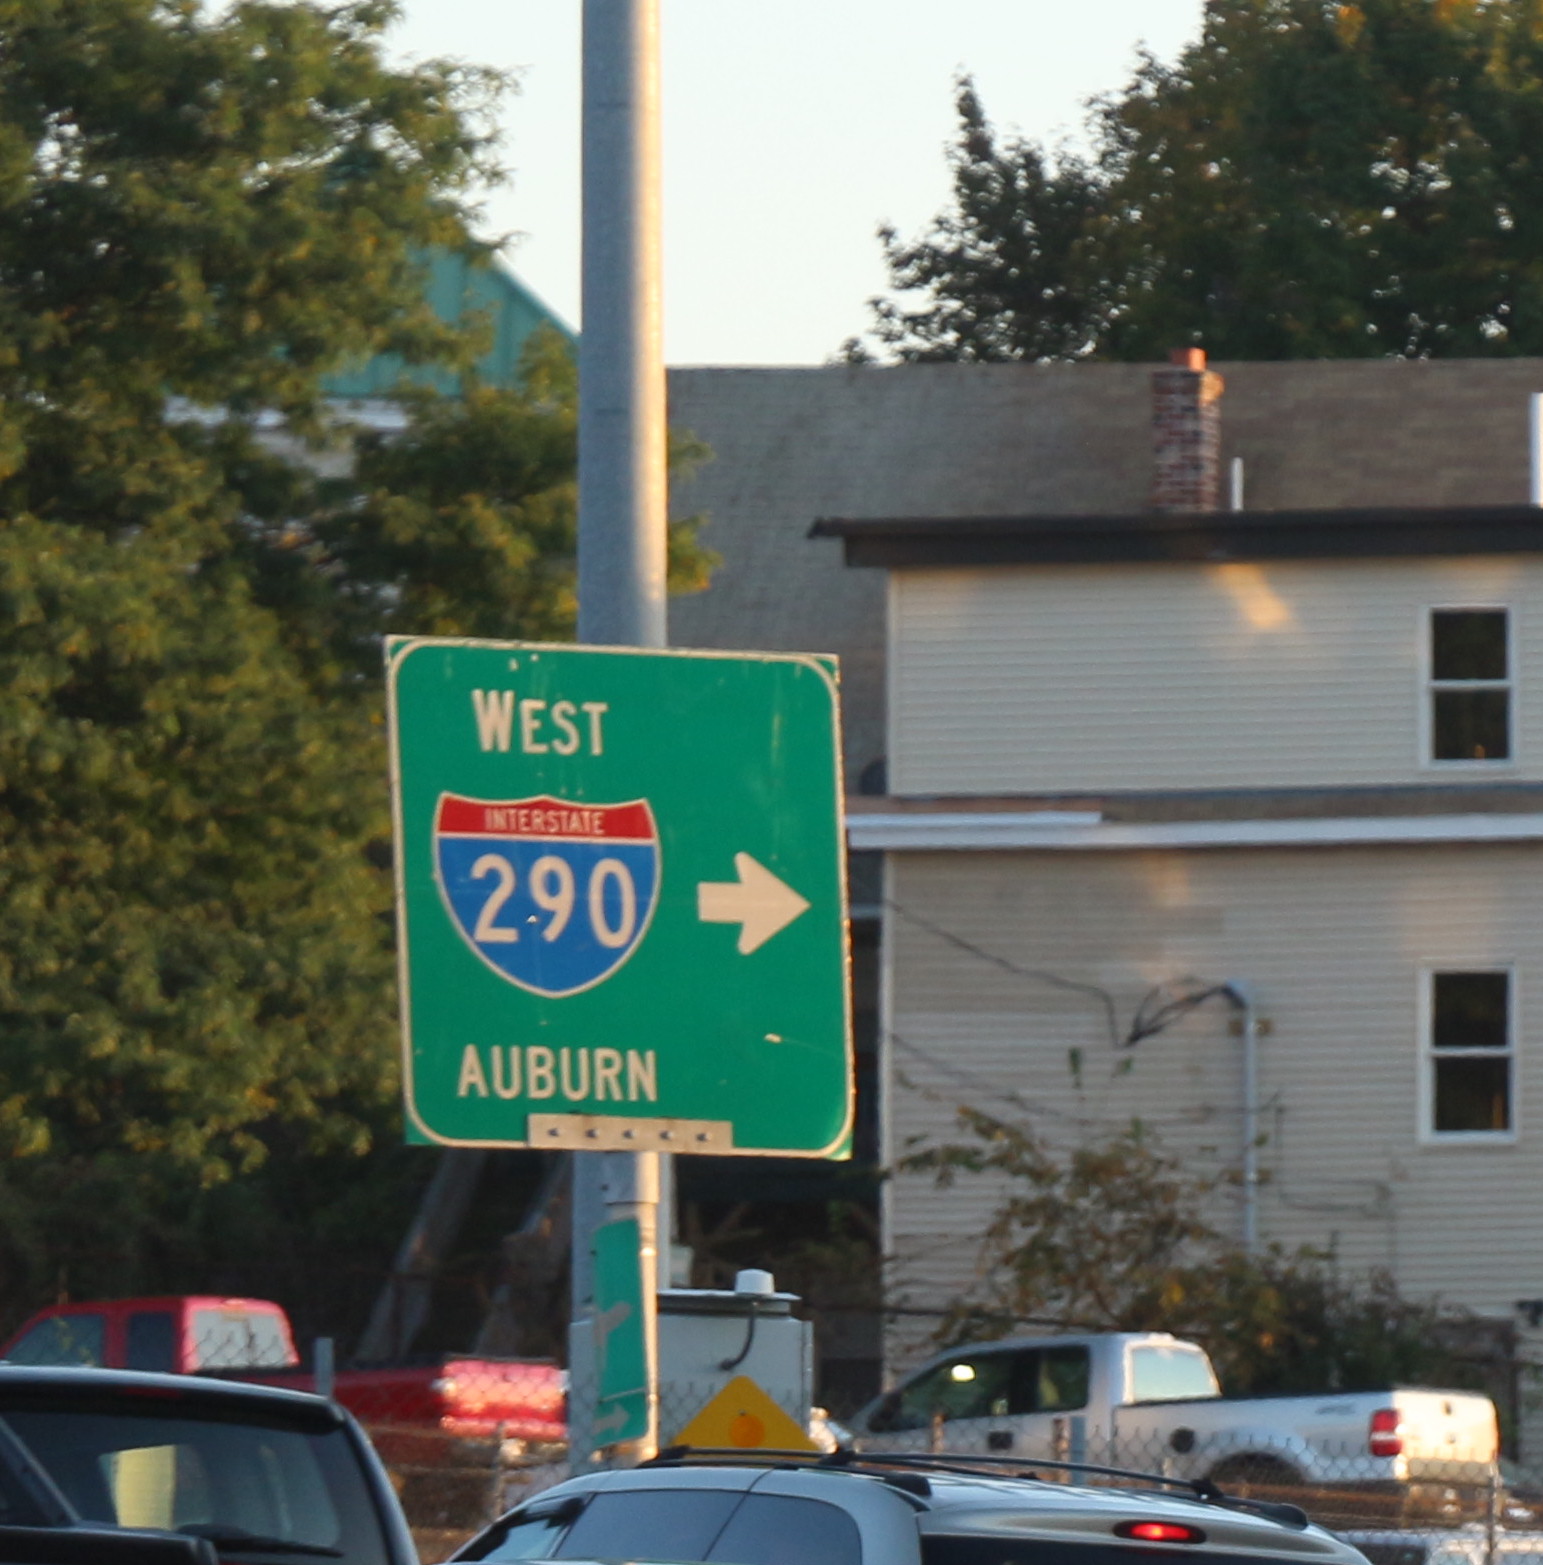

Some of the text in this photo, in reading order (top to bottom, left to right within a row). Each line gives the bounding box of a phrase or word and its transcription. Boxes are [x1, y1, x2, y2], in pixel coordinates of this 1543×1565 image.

[472, 689, 608, 755] WEST
[484, 808, 605, 836] INTERSTATE
[470, 853, 636, 949] 290
[457, 1044, 658, 1102] AUBURN
